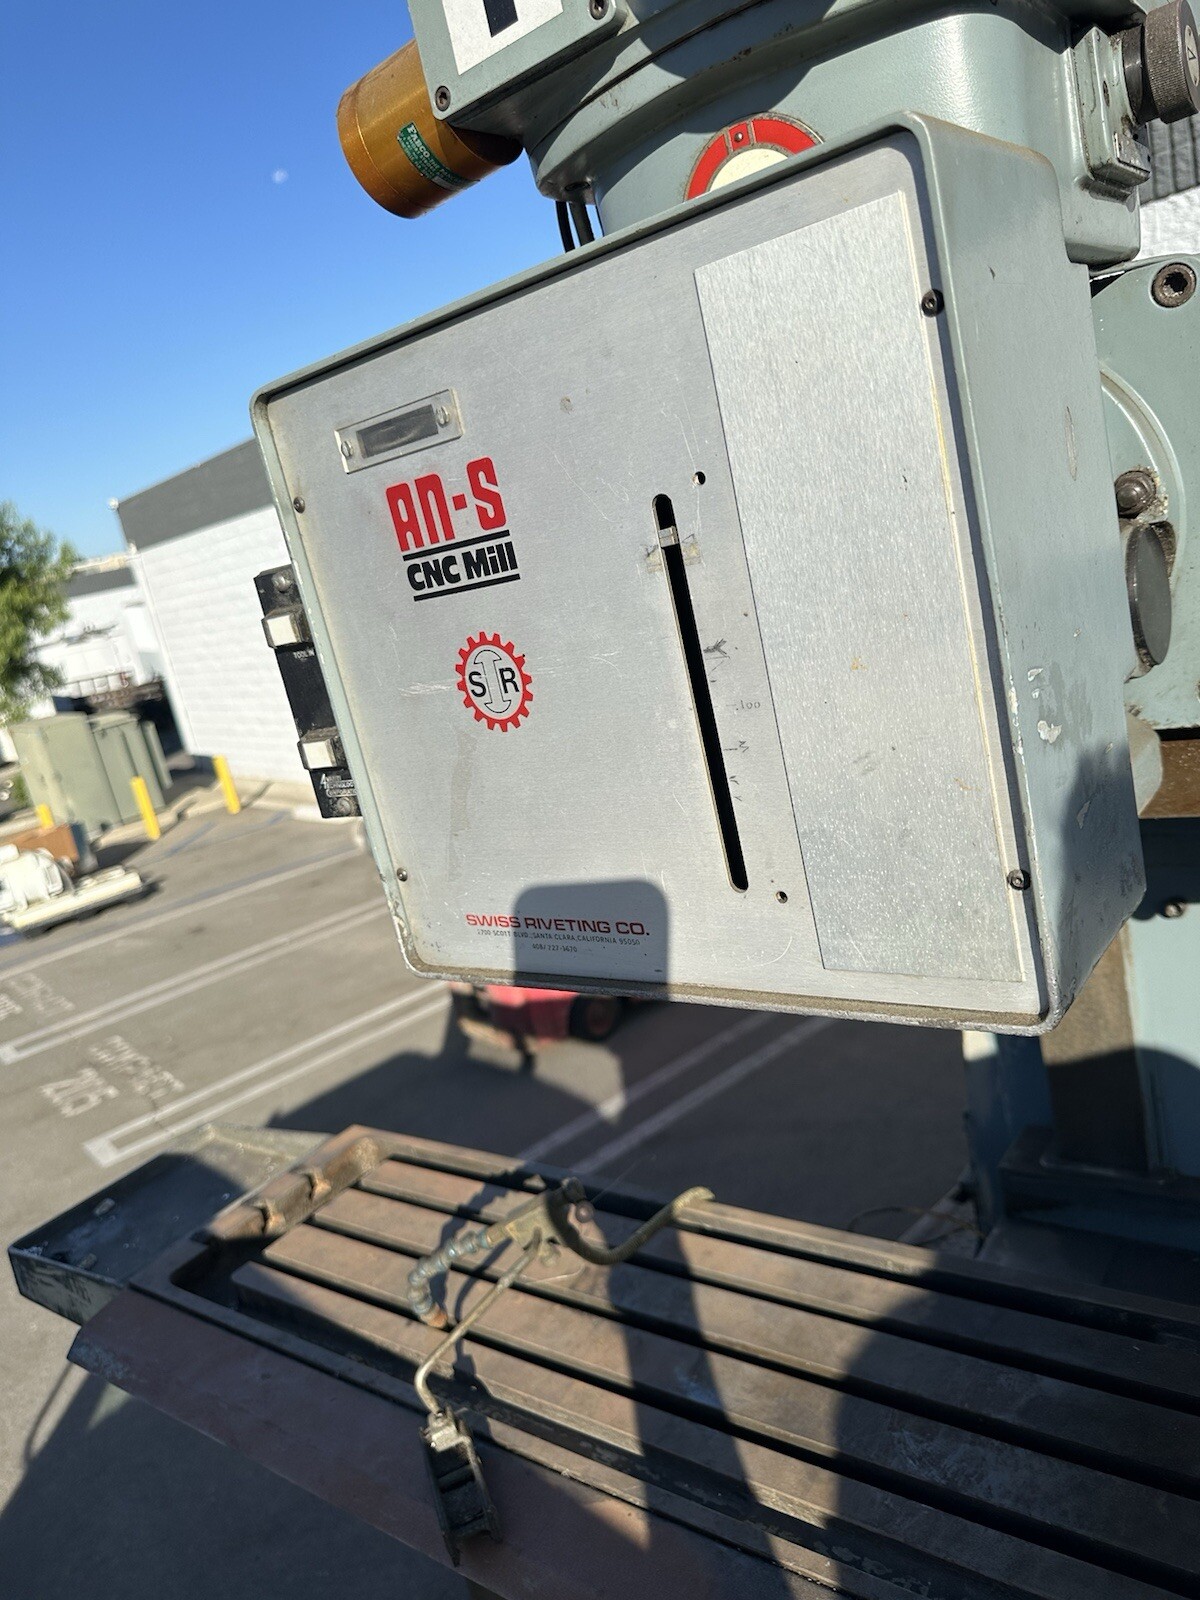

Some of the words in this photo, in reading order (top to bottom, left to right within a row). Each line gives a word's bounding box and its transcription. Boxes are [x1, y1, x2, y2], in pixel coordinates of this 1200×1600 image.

[407, 555, 462, 591] CNC
[461, 541, 519, 580] Mill
[465, 914, 522, 929] SWISS
[524, 917, 611, 933] RIVETING
[615, 921, 650, 936] CO.
